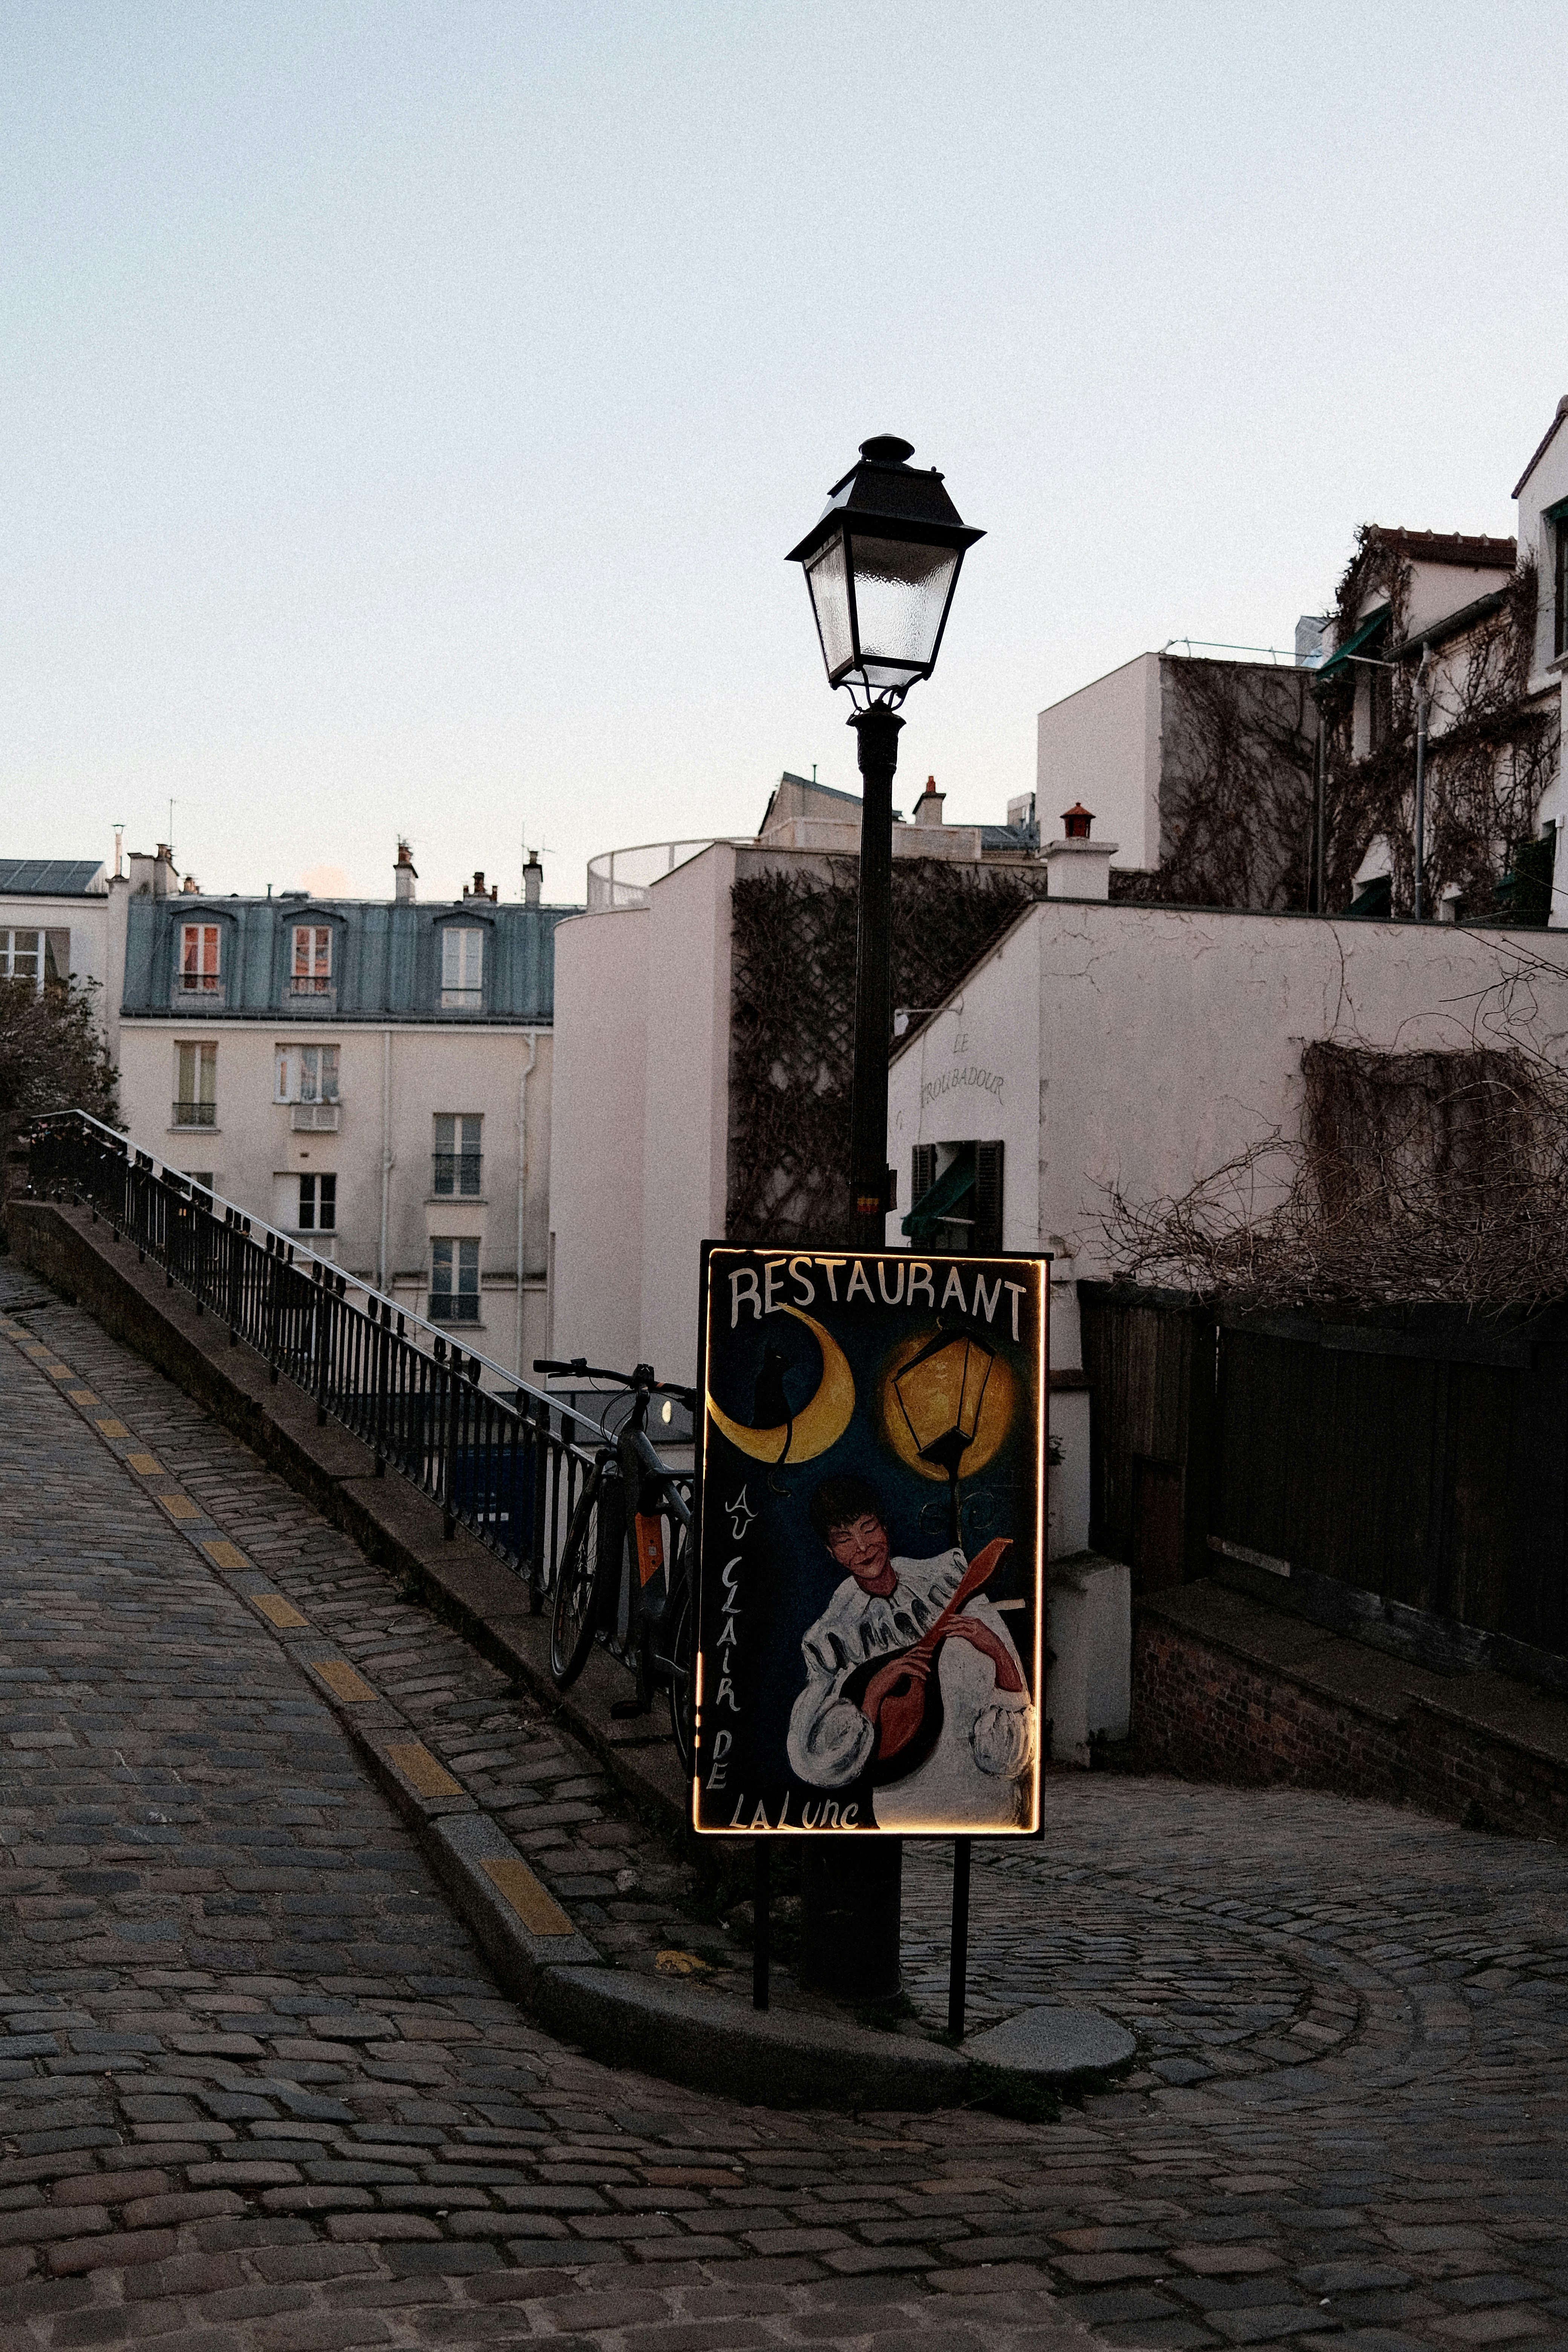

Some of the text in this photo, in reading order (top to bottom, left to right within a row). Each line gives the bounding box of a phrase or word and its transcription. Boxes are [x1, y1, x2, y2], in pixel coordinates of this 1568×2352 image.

[952, 1033, 969, 1054] LE
[728, 1256, 1027, 1341] RESTAURANT
[706, 1483, 759, 1789] AU CLAIR DE
[729, 1793, 772, 1829] LA
